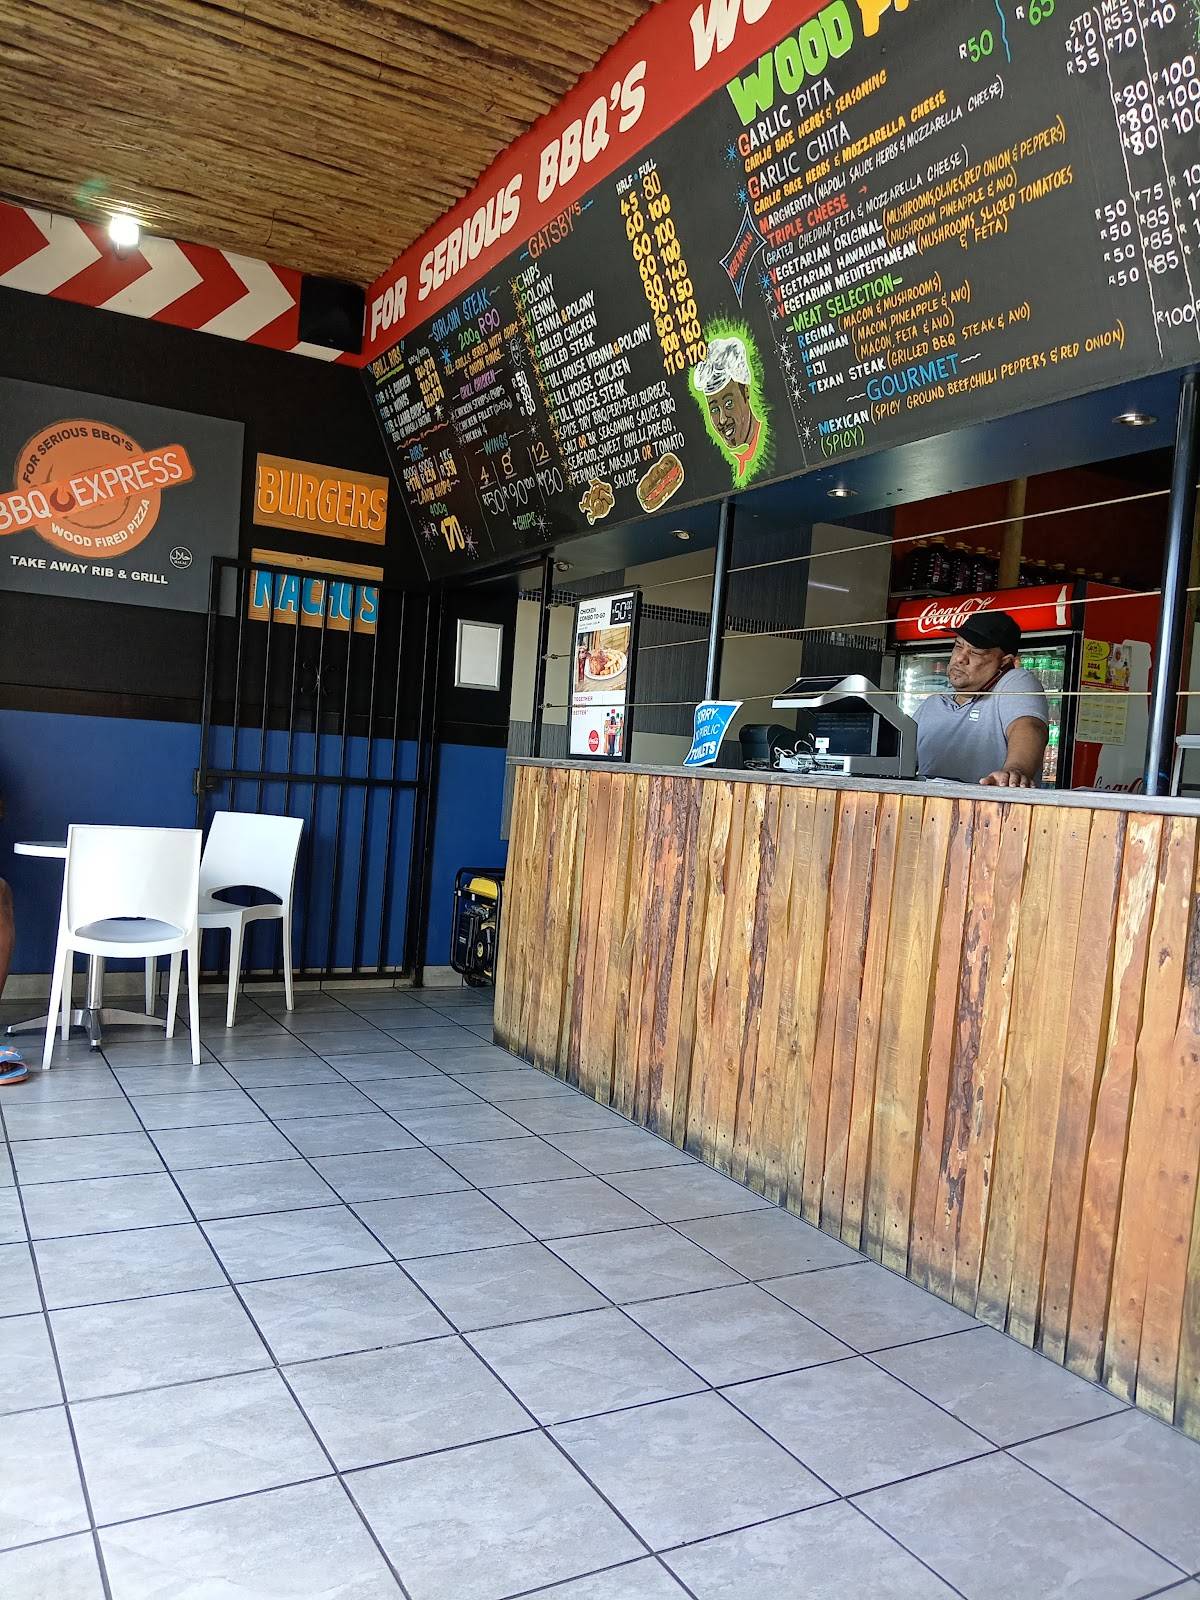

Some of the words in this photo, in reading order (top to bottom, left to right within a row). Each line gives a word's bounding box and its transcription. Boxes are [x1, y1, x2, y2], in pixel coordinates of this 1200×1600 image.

[1065, 28, 1097, 53] R40
[1104, 7, 1133, 33] R55
[1069, 11, 1092, 37] STD
[726, 0, 853, 126] WOOD
[1066, 47, 1100, 76] R55
[1114, 80, 1149, 107] R80
[739, 104, 792, 157] GARLIC
[796, 77, 836, 118] PITA
[744, 146, 772, 174] GARLIC
[775, 131, 795, 154] BASE
[797, 114, 826, 140] HERBS
[835, 70, 888, 115] SEASONING
[1118, 102, 1154, 132] R80
[747, 152, 800, 199] GARLIC
[806, 121, 851, 163] CHITA
[753, 190, 782, 216] GARLIC
[783, 178, 803, 198] BASE
[805, 160, 831, 186] HERBS
[842, 115, 907, 164] MOZZARELLA
[910, 90, 947, 123] CHEESE
[758, 192, 814, 232] MARGHERITA
[848, 156, 873, 184] SAUCE
[875, 143, 899, 167] HERBS
[906, 106, 962, 148] MOZZARELLA
[967, 74, 1005, 112] CHEESE)
[616, 174, 633, 196] HALF
[638, 158, 657, 180] FULL
[620, 190, 639, 217] 45
[642, 171, 661, 200] 80
[865, 172, 922, 212] MOZZARELLA
[927, 144, 969, 182] CHEESE)
[370, 276, 408, 342] FOR
[417, 173, 523, 303] SERIOUS
[537, 60, 648, 204] BBQ'S
[625, 210, 644, 241] 60
[648, 193, 671, 221] 100
[769, 243, 831, 285] VEGETARIAN
[833, 219, 884, 252] ORIGINAL
[983, 149, 1011, 177] ONION
[1020, 114, 1066, 160] PEPPERS)
[1094, 199, 1127, 223] R50
[1134, 183, 1164, 205] R75
[632, 232, 652, 261] 60
[653, 217, 675, 248] 100
[766, 218, 803, 249] TRIPLE
[807, 193, 849, 226] CHEESE
[974, 214, 1008, 244] FETA)
[1100, 220, 1131, 241] R50
[1139, 205, 1169, 229] R85
[639, 254, 657, 281] 60
[660, 237, 680, 266] 100
[773, 263, 833, 302] VEGETARIAN
[836, 235, 887, 270] HAWAIIAN
[939, 187, 984, 221] PINEAPPLE
[777, 283, 833, 319] VEGETARIAN
[979, 194, 1016, 222] SLICED
[1018, 164, 1073, 203] TOMATOES
[1104, 244, 1135, 263] R50
[1143, 227, 1173, 250] R85
[515, 262, 541, 291] CHIPS
[643, 273, 663, 302] 80
[1108, 267, 1139, 287] R50
[1147, 251, 1179, 274] R85
[462, 287, 491, 320] STEAK
[520, 273, 553, 310] POLONY
[524, 295, 557, 325] VIENNA
[650, 293, 668, 320] 90
[670, 277, 693, 303] 150
[793, 307, 822, 333] MEAT
[828, 273, 895, 318] SELECTION
[478, 307, 500, 337] R90
[535, 335, 564, 359] GRILLED
[563, 311, 597, 341] CHICKEN
[656, 314, 673, 338] 80
[894, 326, 918, 344] FETA
[1155, 303, 1195, 327] R100
[539, 347, 569, 372] GRILLED
[569, 331, 596, 357] STEAK
[660, 331, 680, 355] 100
[680, 319, 701, 344] 160
[797, 323, 835, 350] REGINA
[801, 334, 849, 363] HAWAIIAN
[544, 366, 563, 391] FULL
[562, 358, 587, 384] HOUSE
[663, 350, 685, 375] 110
[685, 340, 708, 365] 170
[808, 372, 844, 399] TEXAN
[848, 357, 886, 382] STEAK
[931, 333, 956, 353] BBQ
[961, 320, 995, 340] STEAK
[865, 353, 960, 401] GOURMET
[549, 383, 571, 408] FULL
[569, 375, 594, 400] HOUSE
[594, 356, 631, 386] CHICKEN
[553, 400, 577, 425] FULL
[574, 394, 600, 419] HOUSE
[599, 379, 628, 406] STEAK
[817, 409, 870, 437] MEXICAN
[906, 386, 945, 410] GROUND
[1000, 355, 1047, 379] PEPPERS
[1059, 344, 1080, 360] RED
[482, 432, 510, 456] WINGS
[560, 423, 579, 440] SPICE
[563, 437, 578, 456] SALT
[577, 436, 588, 450] OR
[598, 414, 634, 442] SEASONING
[636, 406, 660, 429] SAUCE
[661, 397, 676, 416] BBQ
[641, 445, 654, 461] OR
[653, 431, 685, 458] TOMATO
[820, 426, 866, 458] (SPICY)
[22, 454, 41, 484] FOR
[37, 427, 88, 456] SERIOUS
[91, 428, 134, 452] BBQ'S
[531, 441, 550, 463] 12
[69, 452, 183, 507] EXPRESS
[257, 465, 387, 532] BURGERS
[613, 468, 639, 490] SAUCE
[51, 521, 92, 547] WOOD
[95, 530, 128, 548] FIRED
[127, 498, 151, 536] PIZZA
[10, 555, 46, 570] TAKE
[49, 560, 89, 575] AWAY
[92, 566, 114, 578] RIB
[117, 569, 127, 579] &
[131, 571, 169, 585] GRILL
